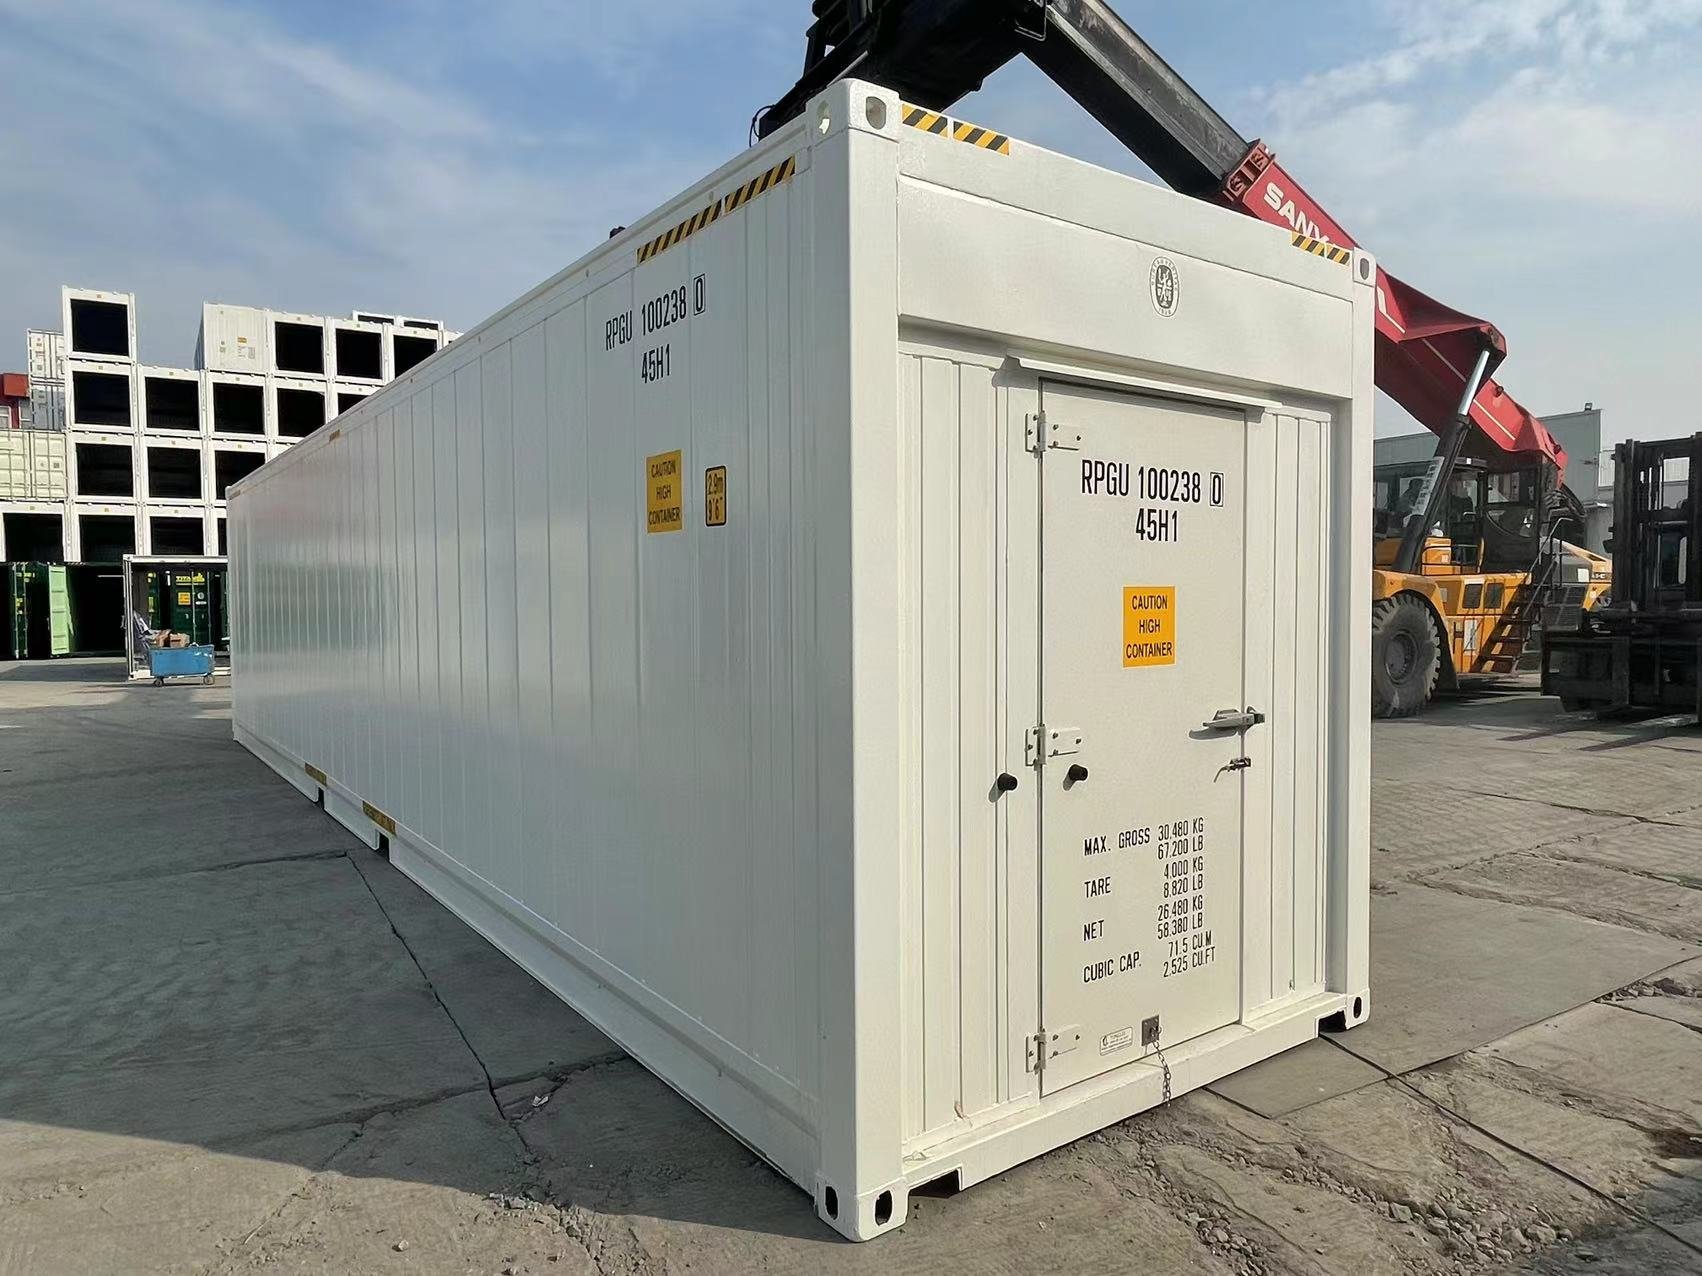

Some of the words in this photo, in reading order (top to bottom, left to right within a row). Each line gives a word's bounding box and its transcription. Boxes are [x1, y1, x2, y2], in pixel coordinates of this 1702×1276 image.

[605, 310, 633, 351] RPGU
[641, 285, 687, 336] 100238
[695, 275, 705, 315] 0
[641, 343, 670, 384] 45H1
[651, 460, 677, 478] CAUTION
[1081, 459, 1130, 497] RPGU
[1138, 466, 1201, 503] 100238
[1211, 474, 1222, 505] 0
[656, 484, 672, 500] HIGH
[648, 506, 680, 525] CONTAINER
[1135, 508, 1178, 542] 45H1
[1131, 594, 1168, 610] CAUTION
[1138, 618, 1161, 634] HIGH
[1125, 641, 1173, 659] CONTAINER
[1084, 835, 1111, 856] MAX.
[1118, 827, 1150, 849] GROSS
[1158, 820, 1189, 841] 30.480
[1192, 817, 1204, 834] KG
[1157, 838, 1189, 860] 67.200
[1192, 835, 1204, 852] LB
[1084, 876, 1111, 898] TARE
[1163, 859, 1189, 880] 4.000
[1192, 855, 1204, 873] KG
[1163, 877, 1189, 898] 8.820
[1192, 873, 1203, 891] LB
[1083, 919, 1105, 941] NET
[1157, 898, 1189, 921] 26.480
[1192, 894, 1203, 912] KG
[1157, 916, 1188, 940] 58.380
[1192, 912, 1203, 930] LB
[1083, 958, 1114, 983] CUBIC
[1119, 951, 1142, 972] CAP.
[1168, 937, 1188, 958] 71.5
[1192, 930, 1212, 950] CU.M
[1163, 955, 1188, 978] 2.525
[1192, 946, 1216, 968] CU.FT
